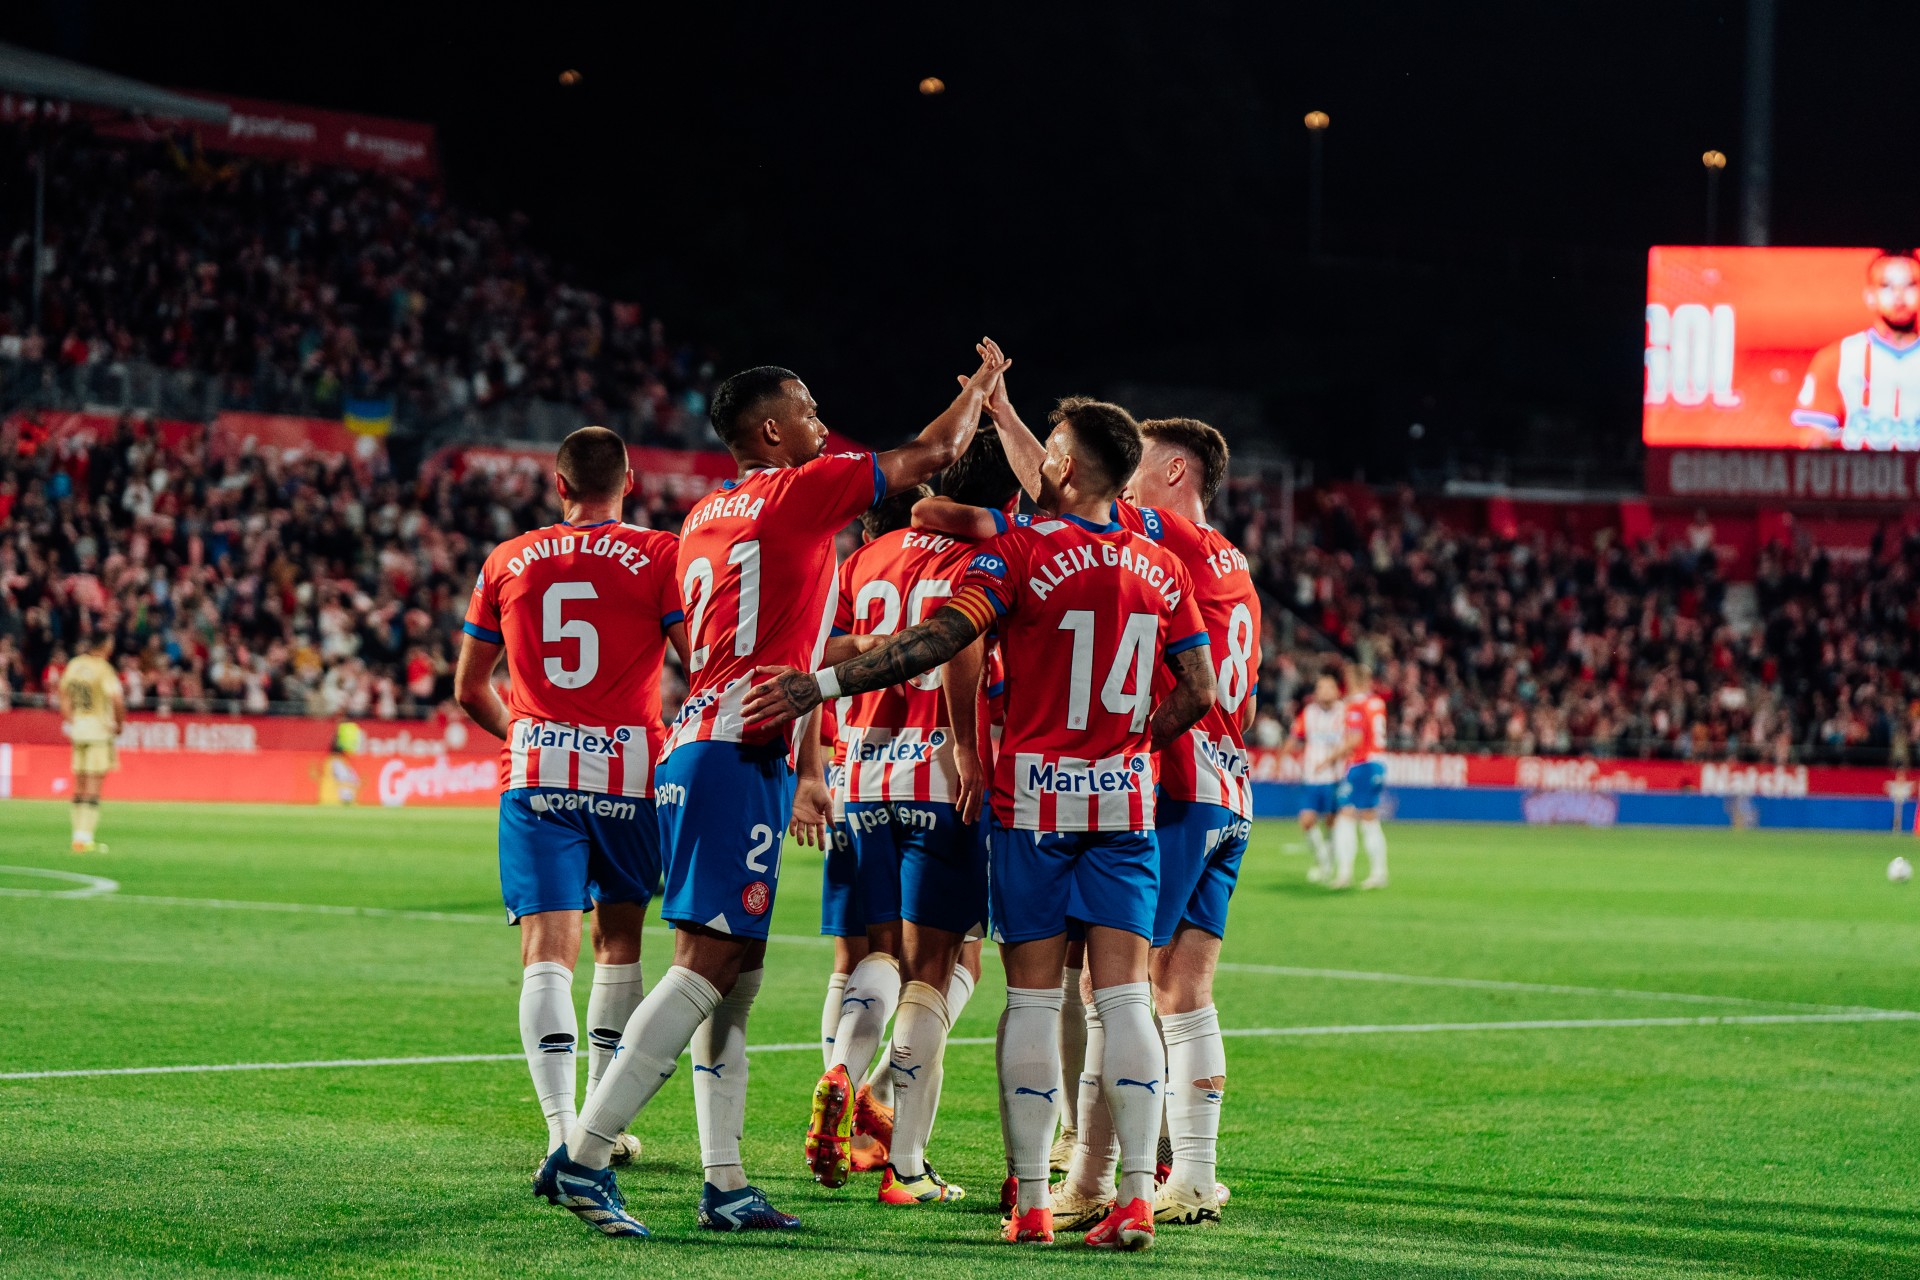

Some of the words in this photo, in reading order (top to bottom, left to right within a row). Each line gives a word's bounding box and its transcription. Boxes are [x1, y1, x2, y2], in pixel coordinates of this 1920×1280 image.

[1669, 453, 1788, 493] GIRONA
[1795, 453, 1908, 496] FUTBOL
[683, 493, 765, 542] HERRERA
[507, 535, 574, 576] DAVID
[581, 534, 650, 576] LÓPEZ
[1029, 544, 1100, 601] ALEIX
[1102, 544, 1181, 611] GARCIA
[683, 539, 761, 673] 21
[543, 581, 599, 689] 5
[1216, 602, 1253, 714] 8
[1058, 609, 1159, 733] 14
[521, 725, 617, 756] Marlex
[1028, 763, 1134, 792] Marlex
[547, 793, 636, 820] parlem
[859, 802, 937, 833] palem
